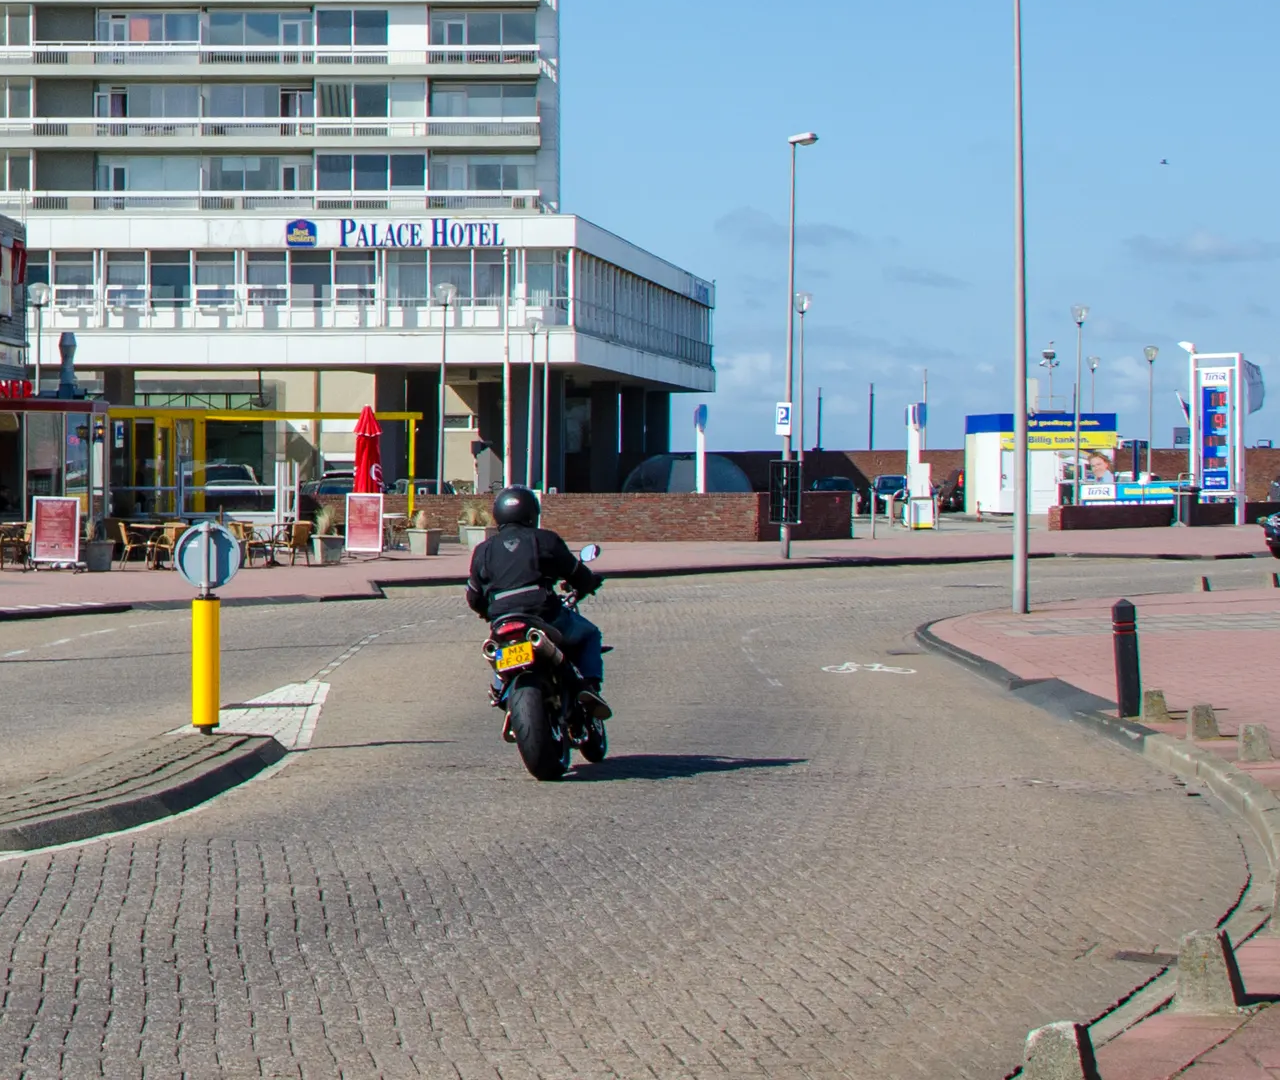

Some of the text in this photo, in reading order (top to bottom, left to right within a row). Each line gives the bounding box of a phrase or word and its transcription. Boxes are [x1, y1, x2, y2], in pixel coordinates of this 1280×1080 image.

[293, 228, 309, 236] Best
[340, 218, 505, 248] PALACE HOTEL
[288, 234, 317, 243] Western
[1028, 435, 1052, 445] Billig
[508, 644, 525, 656] MX
